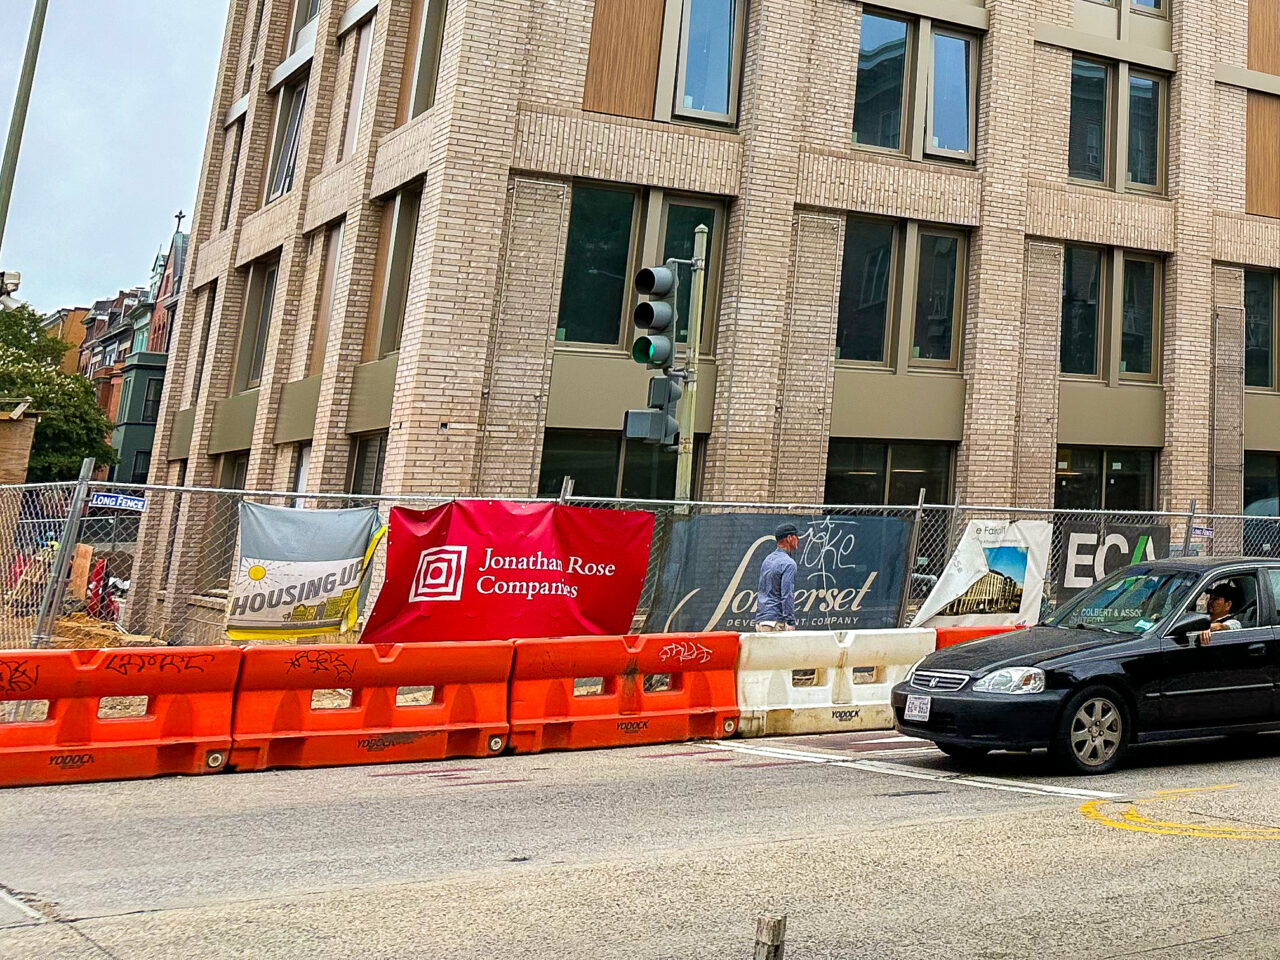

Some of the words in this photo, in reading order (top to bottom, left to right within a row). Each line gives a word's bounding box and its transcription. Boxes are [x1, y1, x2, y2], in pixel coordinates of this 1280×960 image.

[92, 494, 116, 506] LONG
[117, 496, 144, 510] FENCE
[478, 547, 563, 572] Jonathan
[566, 556, 616, 576] Rose
[1063, 532, 1156, 589] ECA
[229, 572, 337, 616] HOUSING
[338, 558, 364, 587] UP
[476, 575, 578, 600] Companies
[663, 535, 877, 632] Soerset
[812, 616, 860, 626] COMPANY
[1081, 608, 1113, 617] COLBERT
[1113, 608, 1119, 617] &
[48, 753, 95, 766] YODOCK
